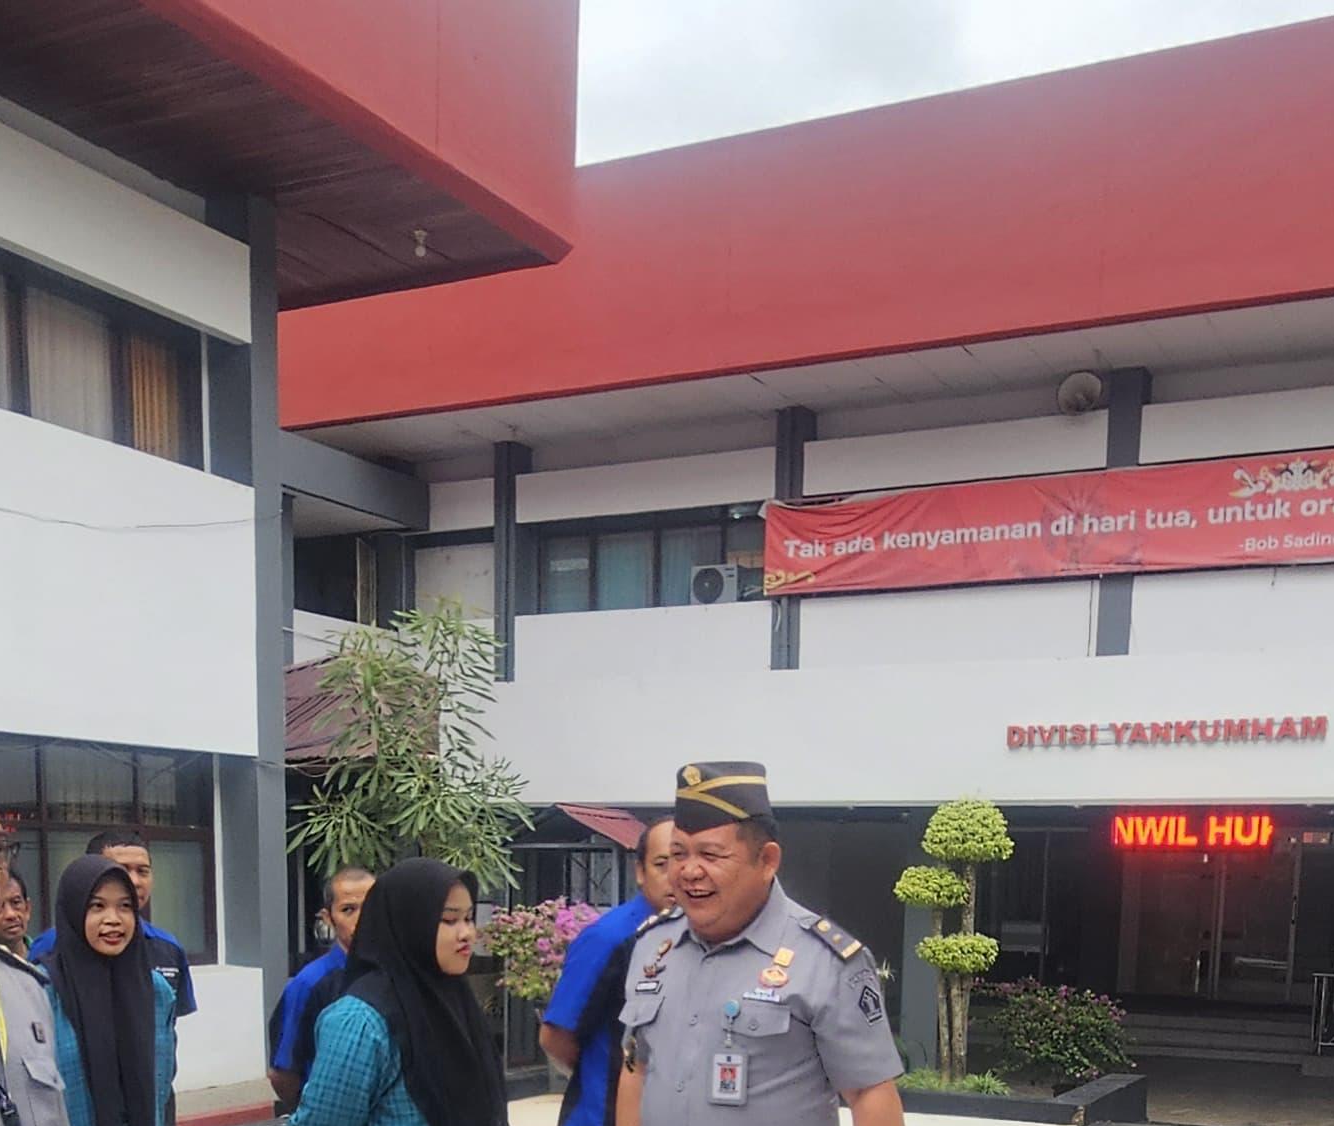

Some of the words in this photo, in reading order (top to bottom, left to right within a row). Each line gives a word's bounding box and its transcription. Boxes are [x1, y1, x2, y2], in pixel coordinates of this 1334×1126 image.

[783, 539, 827, 559] Tak
[834, 537, 876, 556] ada
[882, 519, 1042, 551] kenyamanan
[1051, 515, 1074, 536] di
[1082, 510, 1136, 535] hari
[1145, 508, 1197, 532] tua,
[1207, 500, 1291, 525] untuk
[1006, 724, 1099, 750] DIVISI
[1109, 715, 1328, 746] YANKUMHAM
